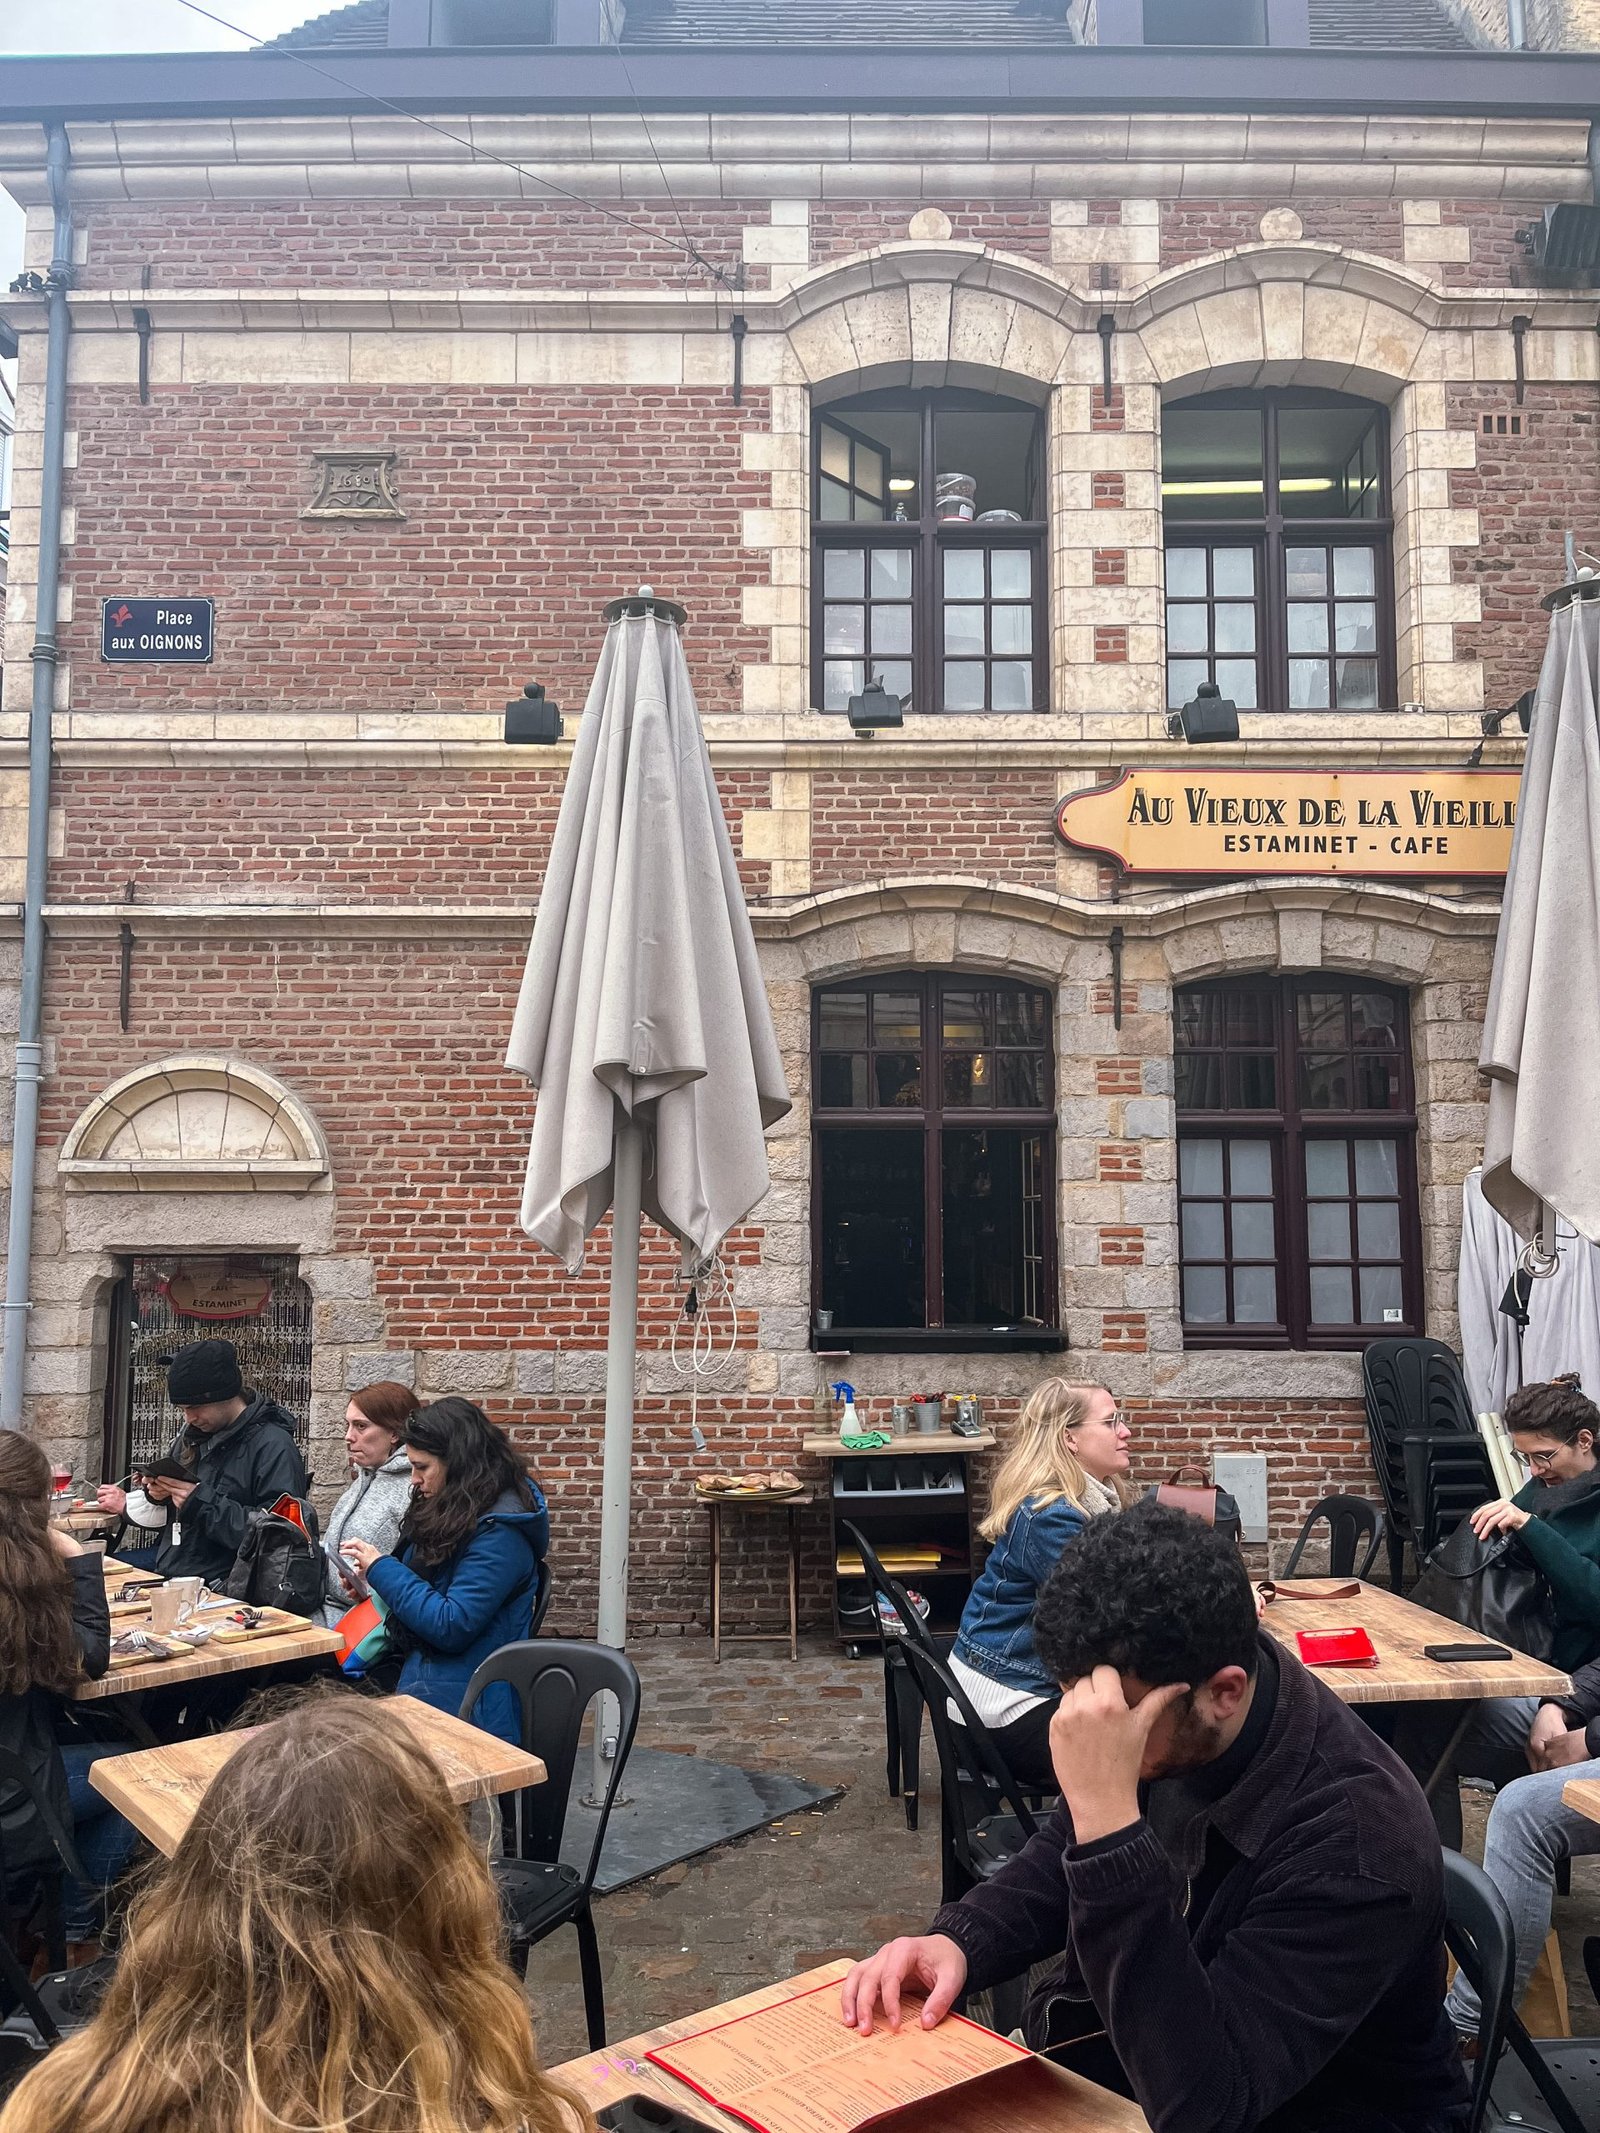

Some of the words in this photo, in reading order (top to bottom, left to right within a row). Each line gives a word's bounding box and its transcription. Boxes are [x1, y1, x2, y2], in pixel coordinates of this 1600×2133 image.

[156, 610, 193, 625] Place
[111, 637, 135, 649] aux
[139, 634, 203, 650] OIGNONS
[1224, 835, 1358, 854] ESTAMINET
[1390, 836, 1448, 855] CAFE
[192, 1298, 247, 1309] ESTAMINET
